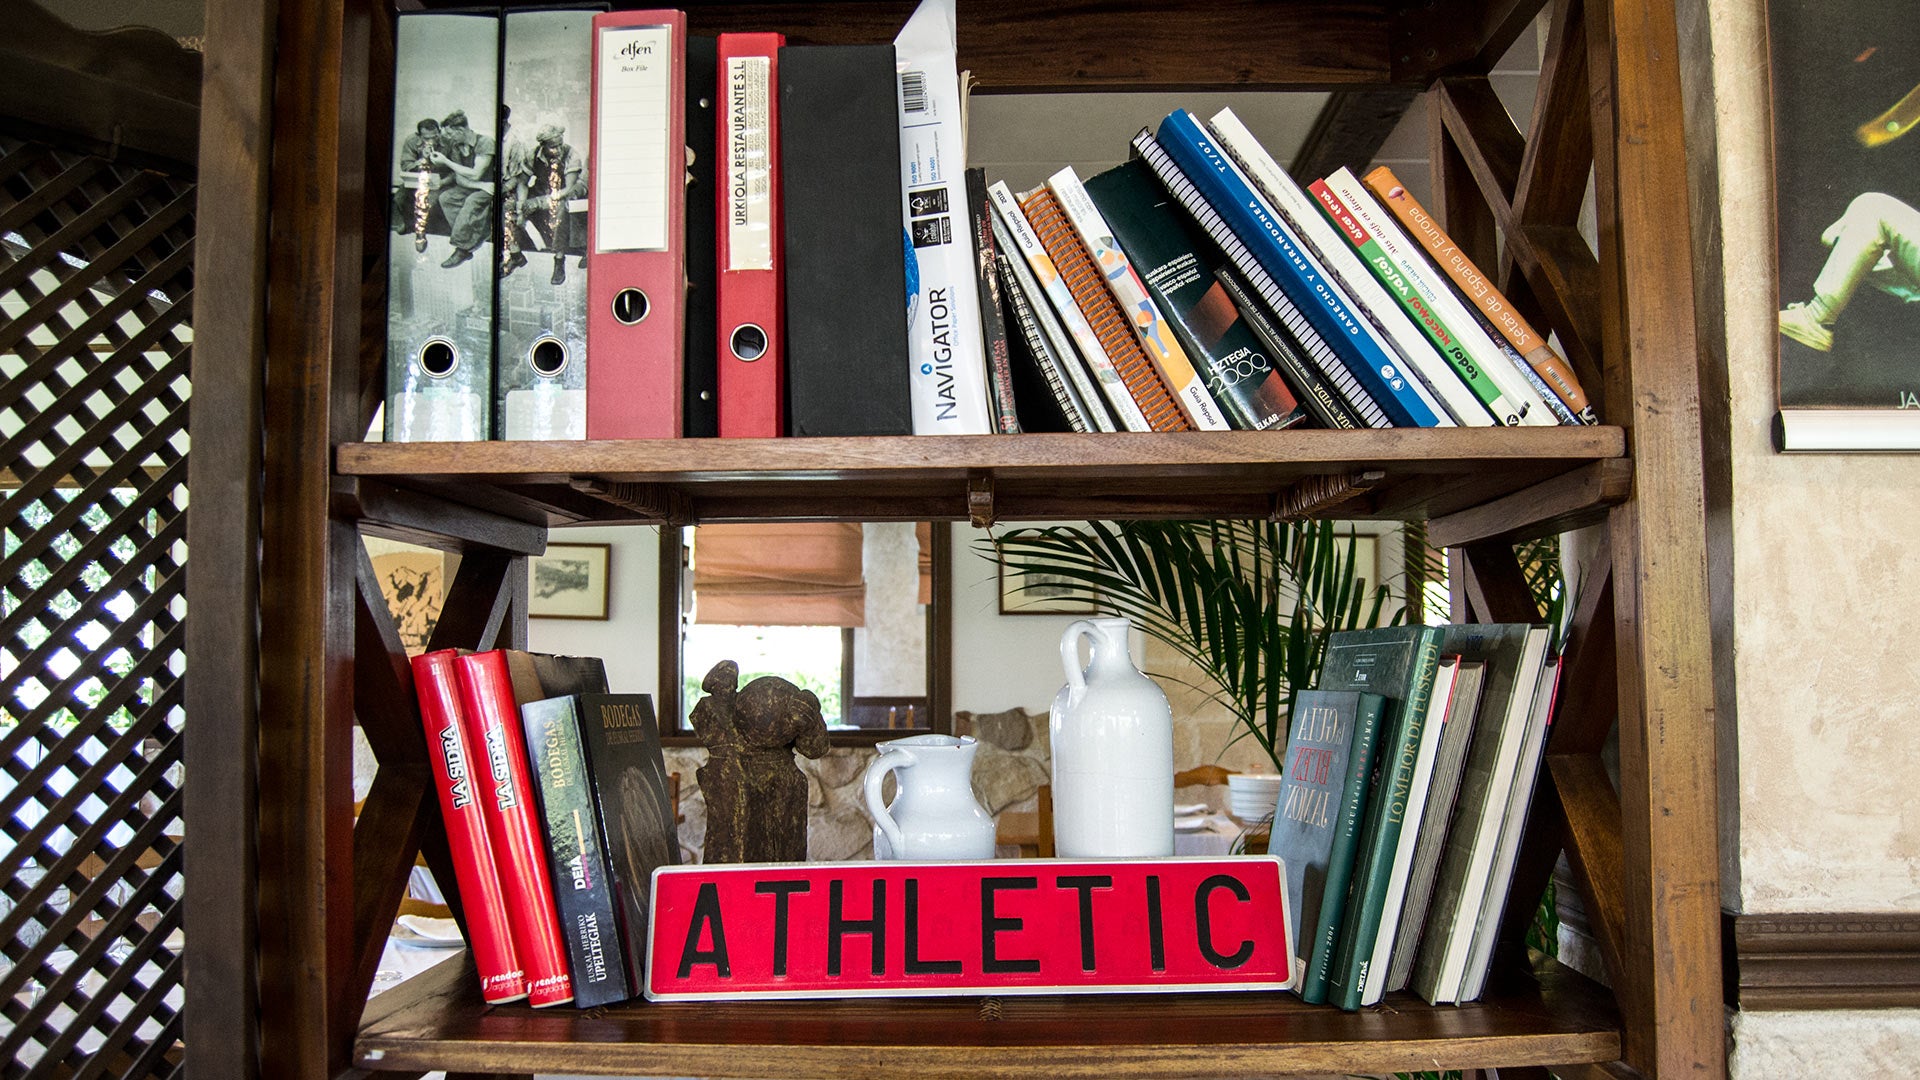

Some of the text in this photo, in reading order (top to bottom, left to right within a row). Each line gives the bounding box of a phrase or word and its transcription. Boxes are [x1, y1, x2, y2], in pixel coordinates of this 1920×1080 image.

[620, 40, 652, 60] elfen
[621, 64, 648, 73] Box File
[734, 61, 746, 226] URKIOLA RESTAURANTE S.L.
[1198, 142, 1225, 173] T1/07
[1342, 189, 1362, 211] directo
[1362, 212, 1371, 221] en
[1007, 210, 1024, 233] Repsol
[1249, 201, 1307, 271] ERRANDONEA
[1367, 219, 1388, 241] chefs
[1409, 207, 1445, 248] Europa
[1382, 238, 1398, 256] Mis
[1442, 244, 1455, 256] y
[1305, 271, 1316, 282] Y
[1373, 257, 1408, 295] vascos
[1451, 253, 1488, 298] España
[1316, 284, 1358, 334] GAMECHO
[1481, 293, 1503, 316] de
[1500, 312, 1530, 345] Setas
[930, 287, 957, 421] NAVIGATOR
[1448, 347, 1478, 380] todos
[1210, 351, 1268, 394] 2000
[1314, 383, 1333, 408] VIDA
[1330, 405, 1338, 413] DE
[1199, 402, 1217, 426] Repsol
[1254, 412, 1279, 431] ELKAR
[599, 703, 641, 728] BODEGAS
[1389, 642, 1438, 823] LO MEJOR DE EUSKADI
[438, 726, 469, 808] LA SIDRA
[486, 725, 517, 810] LA SIDRA
[542, 720, 565, 788] BODEGAS
[569, 854, 585, 890] DEIA
[676, 874, 1255, 979] ATHLETIC
[577, 914, 596, 983] EUSKAL HERRIKO
[585, 912, 607, 981] UPELTEGIAK
